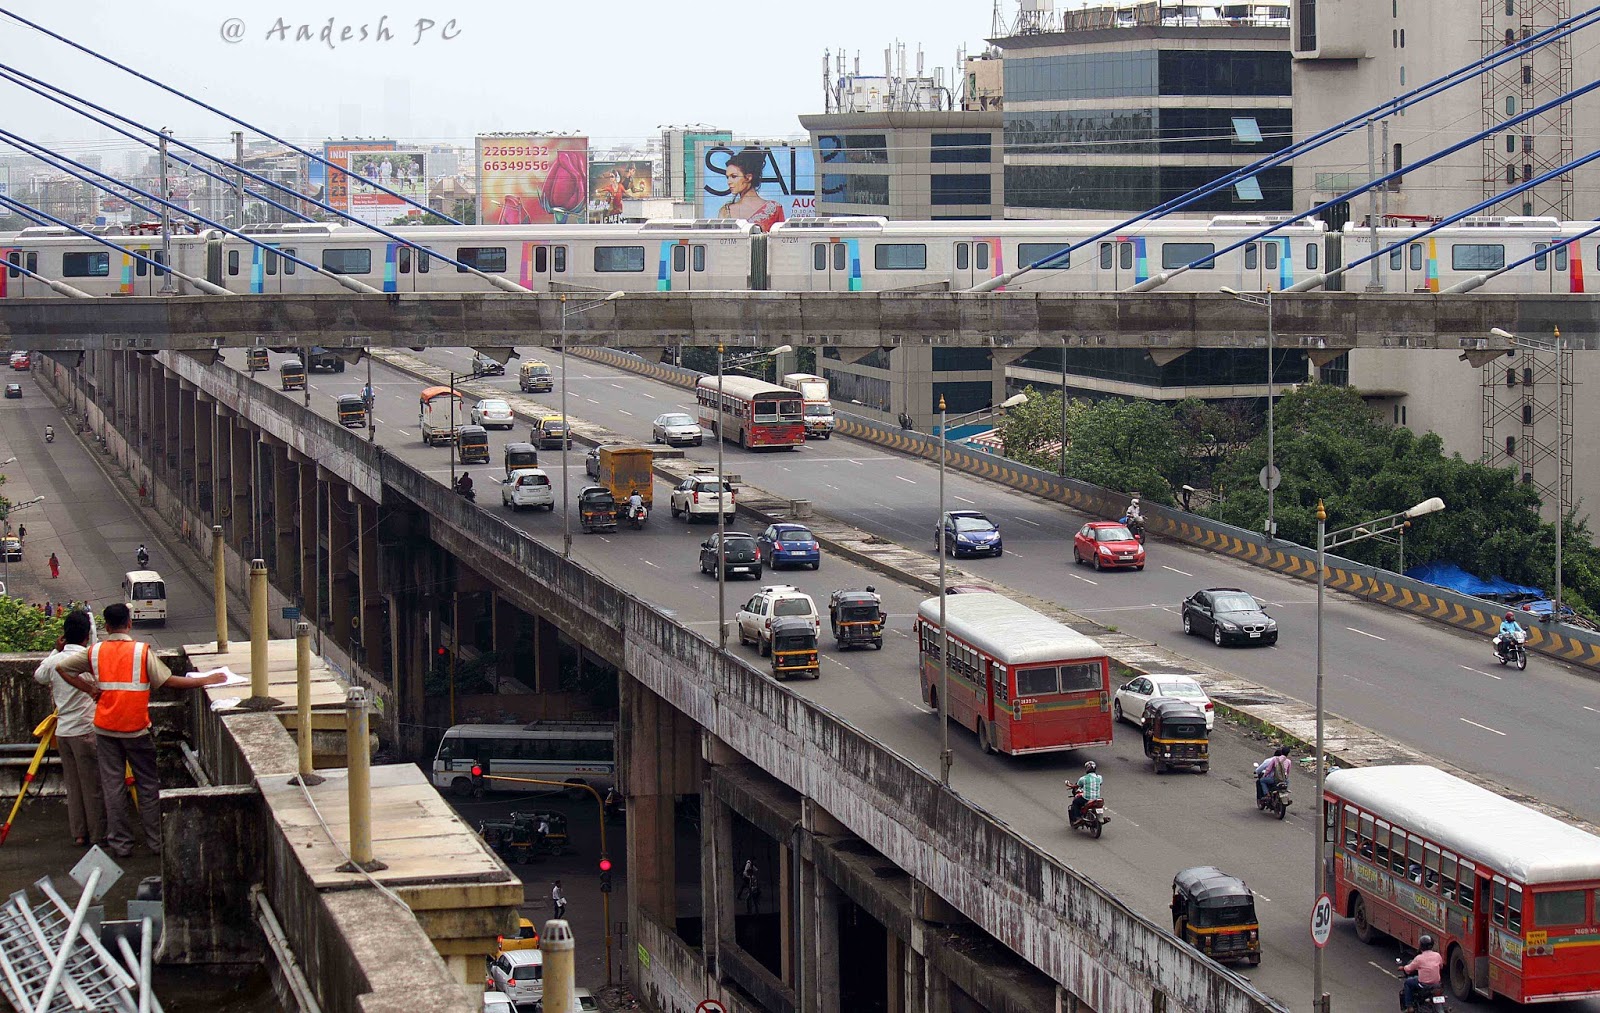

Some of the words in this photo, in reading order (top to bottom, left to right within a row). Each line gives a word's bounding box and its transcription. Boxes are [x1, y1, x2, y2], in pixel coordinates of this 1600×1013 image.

[484, 146, 549, 156] 22659132
[484, 161, 549, 171] 66349556
[1315, 902, 1330, 928] 50
